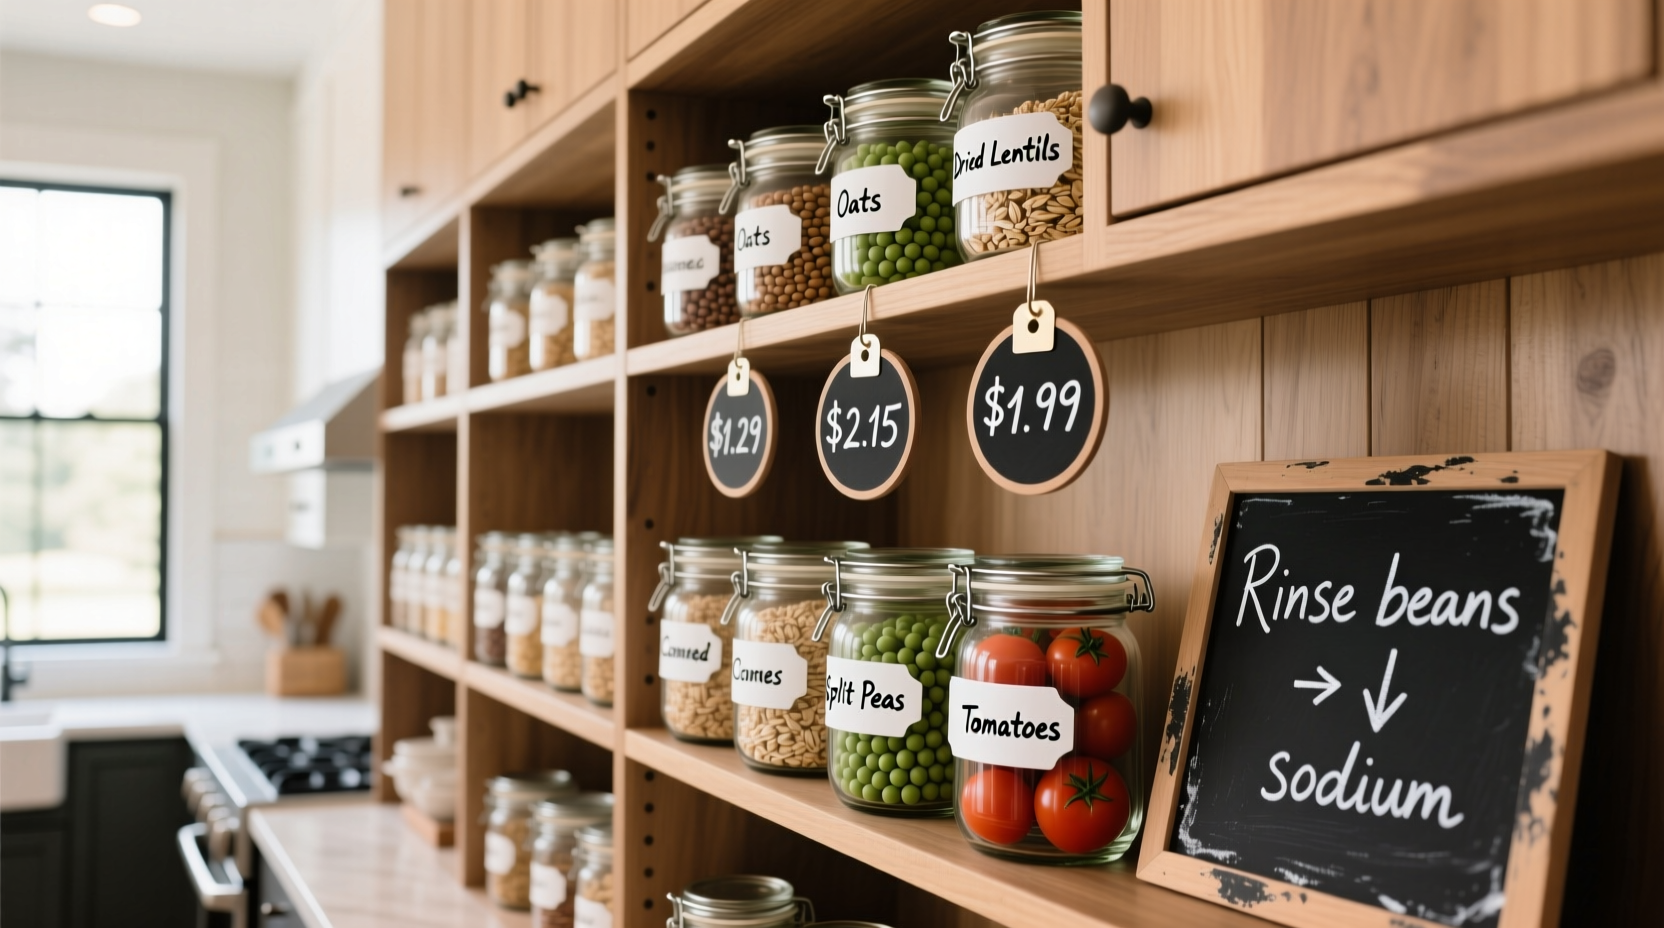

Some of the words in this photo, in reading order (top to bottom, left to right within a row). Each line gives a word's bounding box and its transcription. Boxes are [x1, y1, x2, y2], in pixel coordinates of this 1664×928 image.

[954, 142, 985, 180] Dried
[990, 133, 1060, 167] Lentils
[837, 187, 882, 218] Oats
[737, 225, 771, 251] Oats
[825, 400, 901, 453] $2.15
[983, 376, 1082, 437] $1.99
[709, 411, 762, 458] $1.29
[1235, 543, 1356, 634] Rinse
[1375, 552, 1520, 635] beans
[826, 674, 855, 710] Split
[860, 679, 905, 712] Peas
[961, 704, 1062, 741] Tomatoes
[1260, 740, 1465, 829] sodium
